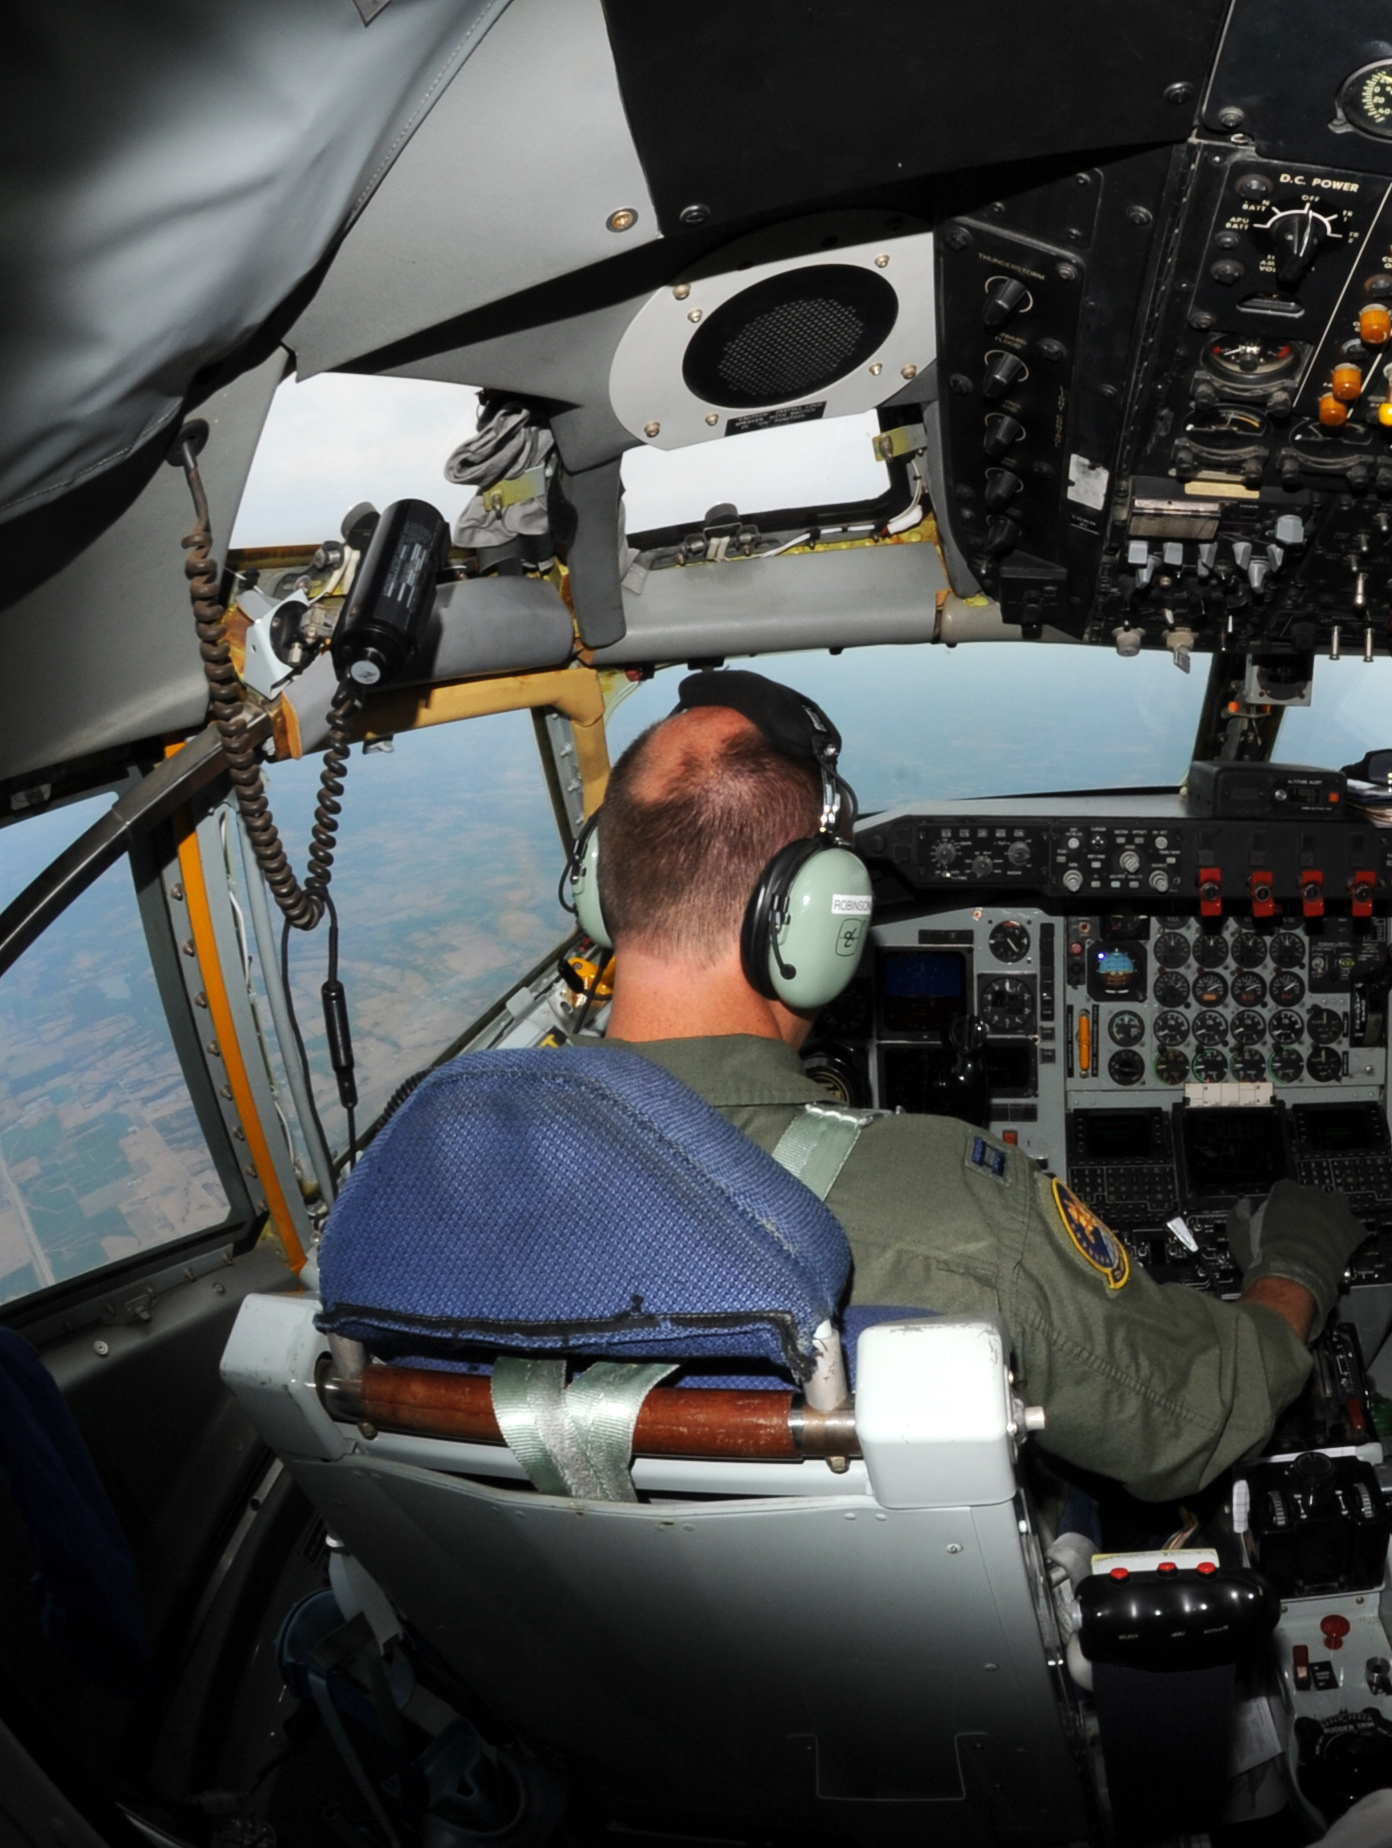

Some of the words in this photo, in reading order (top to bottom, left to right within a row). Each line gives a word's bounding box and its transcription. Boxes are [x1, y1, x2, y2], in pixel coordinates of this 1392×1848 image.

[1279, 173, 1307, 186] D.C.
[1311, 177, 1360, 194] POWER
[1301, 194, 1321, 204] OFF
[1241, 203, 1268, 213] BATT
[1229, 216, 1250, 225] APU
[1225, 222, 1250, 232] BATT
[977, 251, 1047, 283] THUNDERSTORM
[993, 335, 1023, 350] FLOOD
[1323, 1723, 1355, 1734] RUDDER
[1356, 1720, 1376, 1730] TRIM
